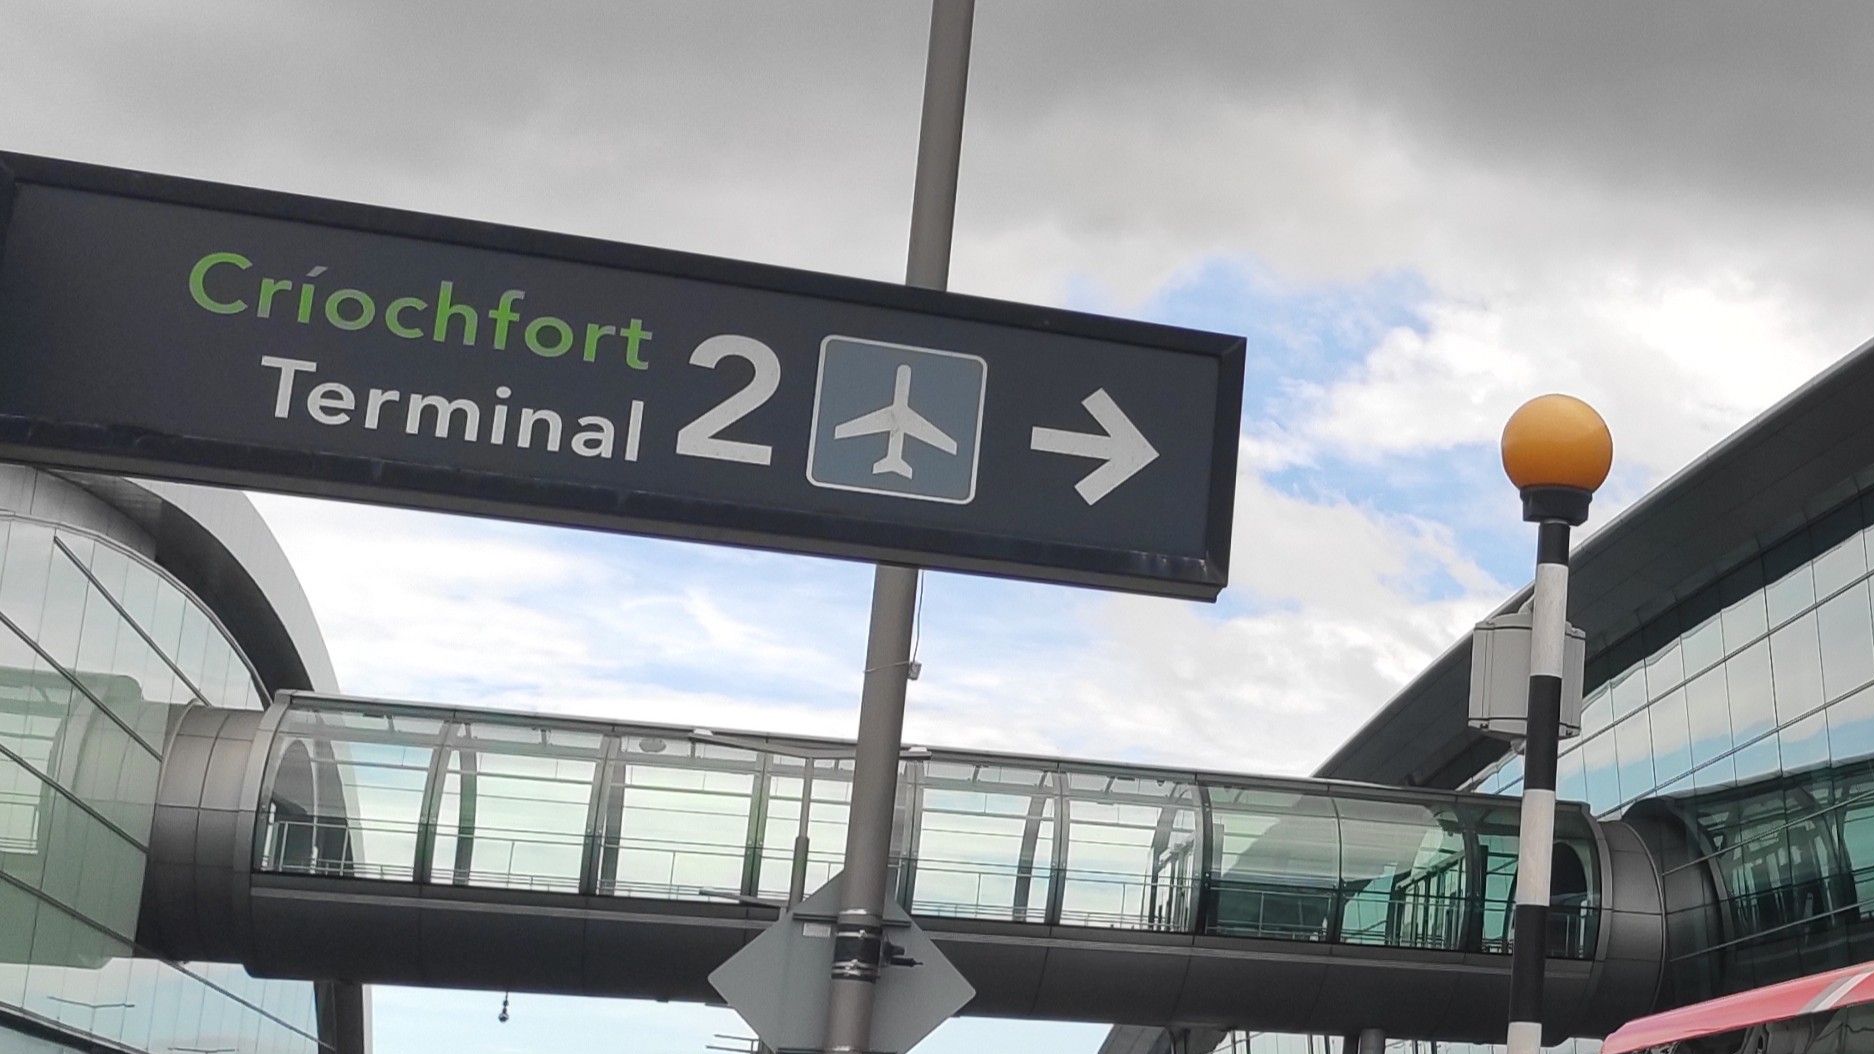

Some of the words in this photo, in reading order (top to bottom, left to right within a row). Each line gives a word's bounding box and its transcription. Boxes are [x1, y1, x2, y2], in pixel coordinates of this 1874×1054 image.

[189, 252, 652, 371] Críochfort
[259, 355, 645, 462] Terminal
[675, 334, 782, 467] 2
